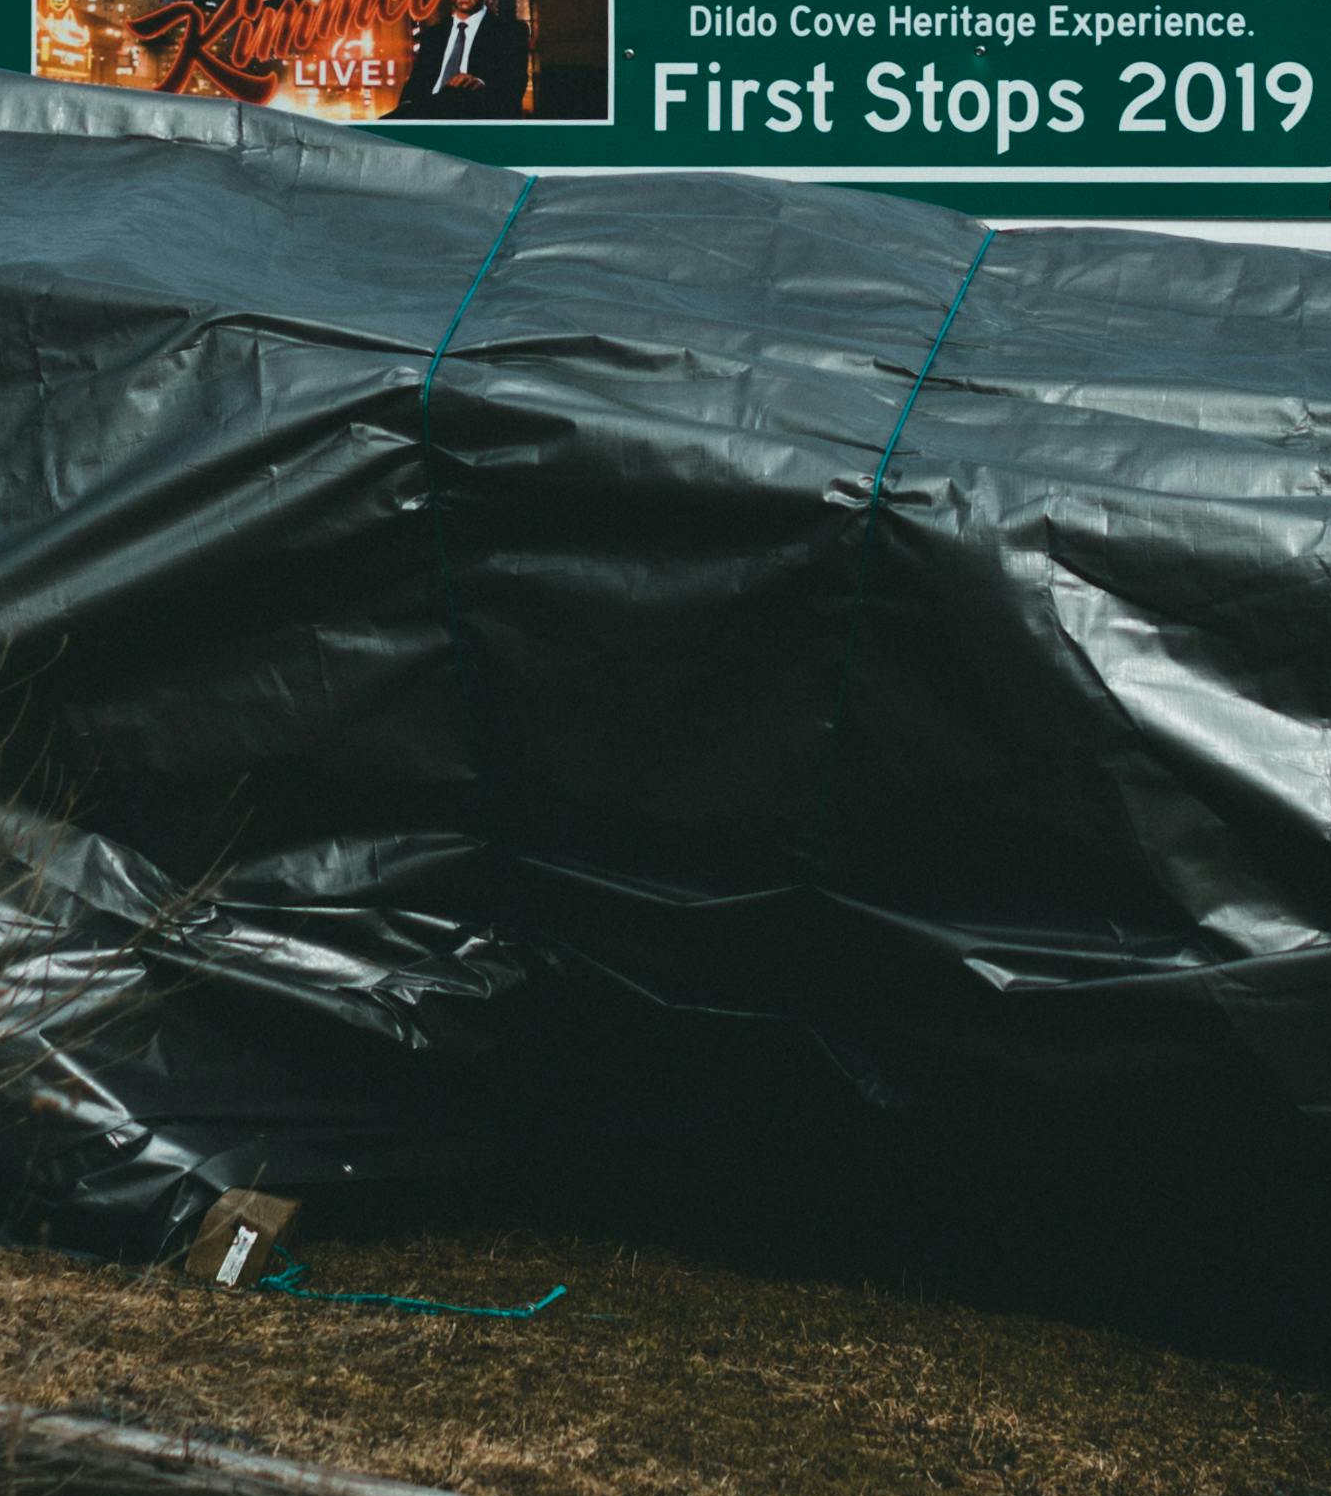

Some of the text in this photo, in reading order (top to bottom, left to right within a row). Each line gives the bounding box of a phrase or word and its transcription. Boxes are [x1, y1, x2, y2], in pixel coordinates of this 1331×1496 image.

[690, 4, 1255, 47] Dildo Cove Heritage Experience.
[294, 59, 396, 87] LIVE!
[654, 61, 1314, 155] First Stops 2019
